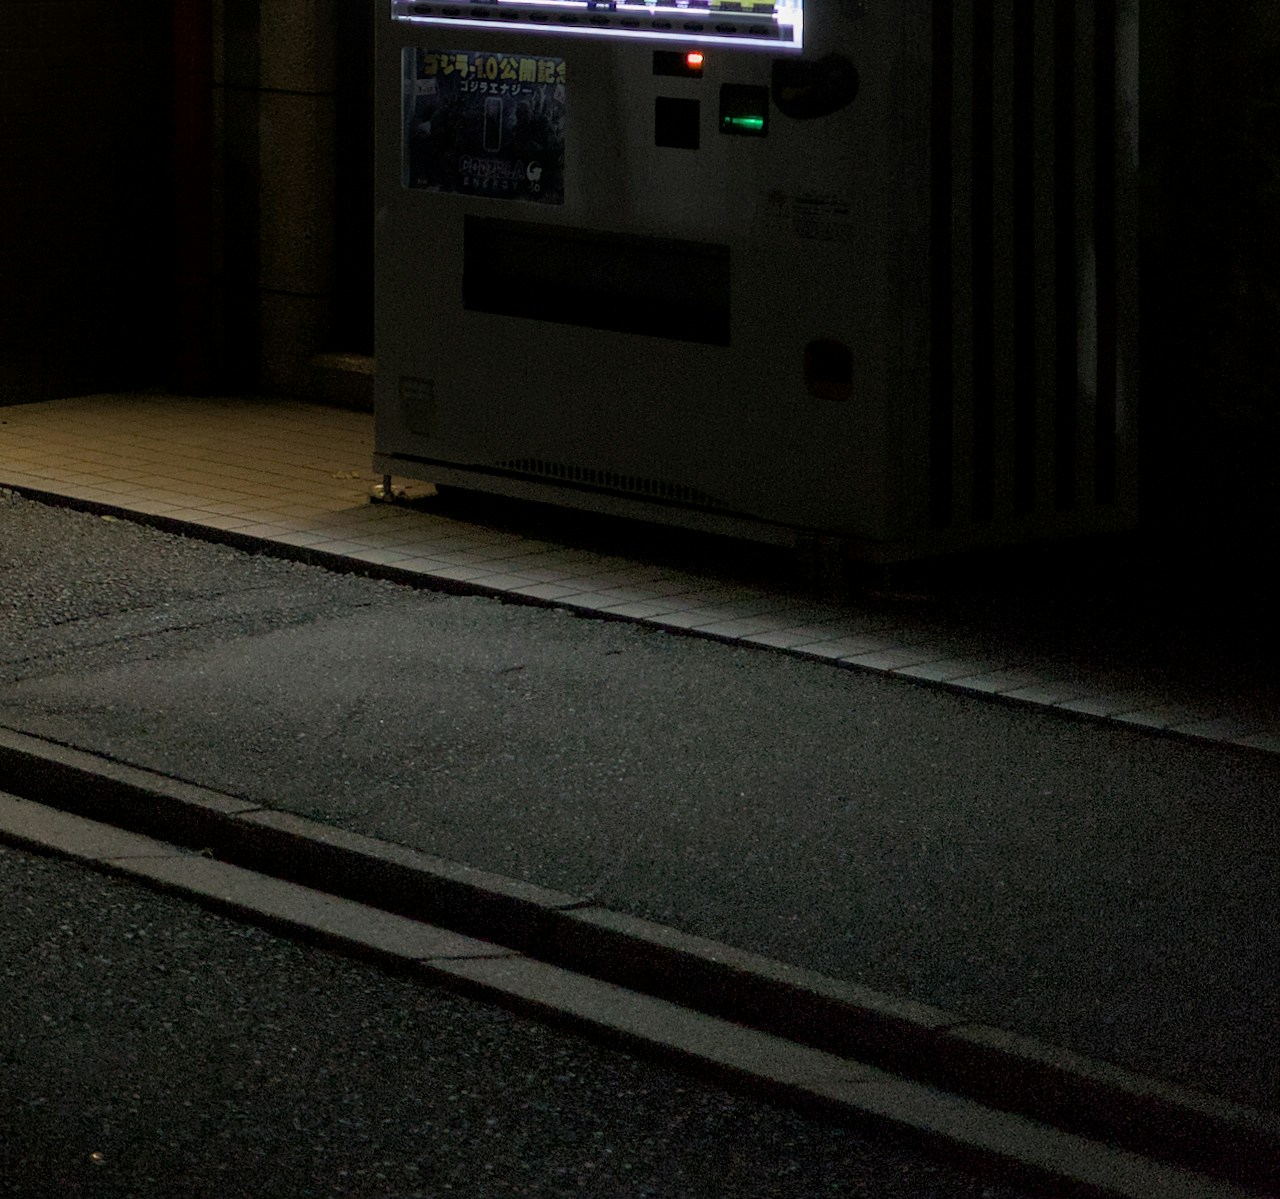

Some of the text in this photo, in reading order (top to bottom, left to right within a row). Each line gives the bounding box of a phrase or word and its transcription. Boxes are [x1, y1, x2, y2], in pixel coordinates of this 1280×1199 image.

[460, 81, 533, 96] ゴジラエナジー
